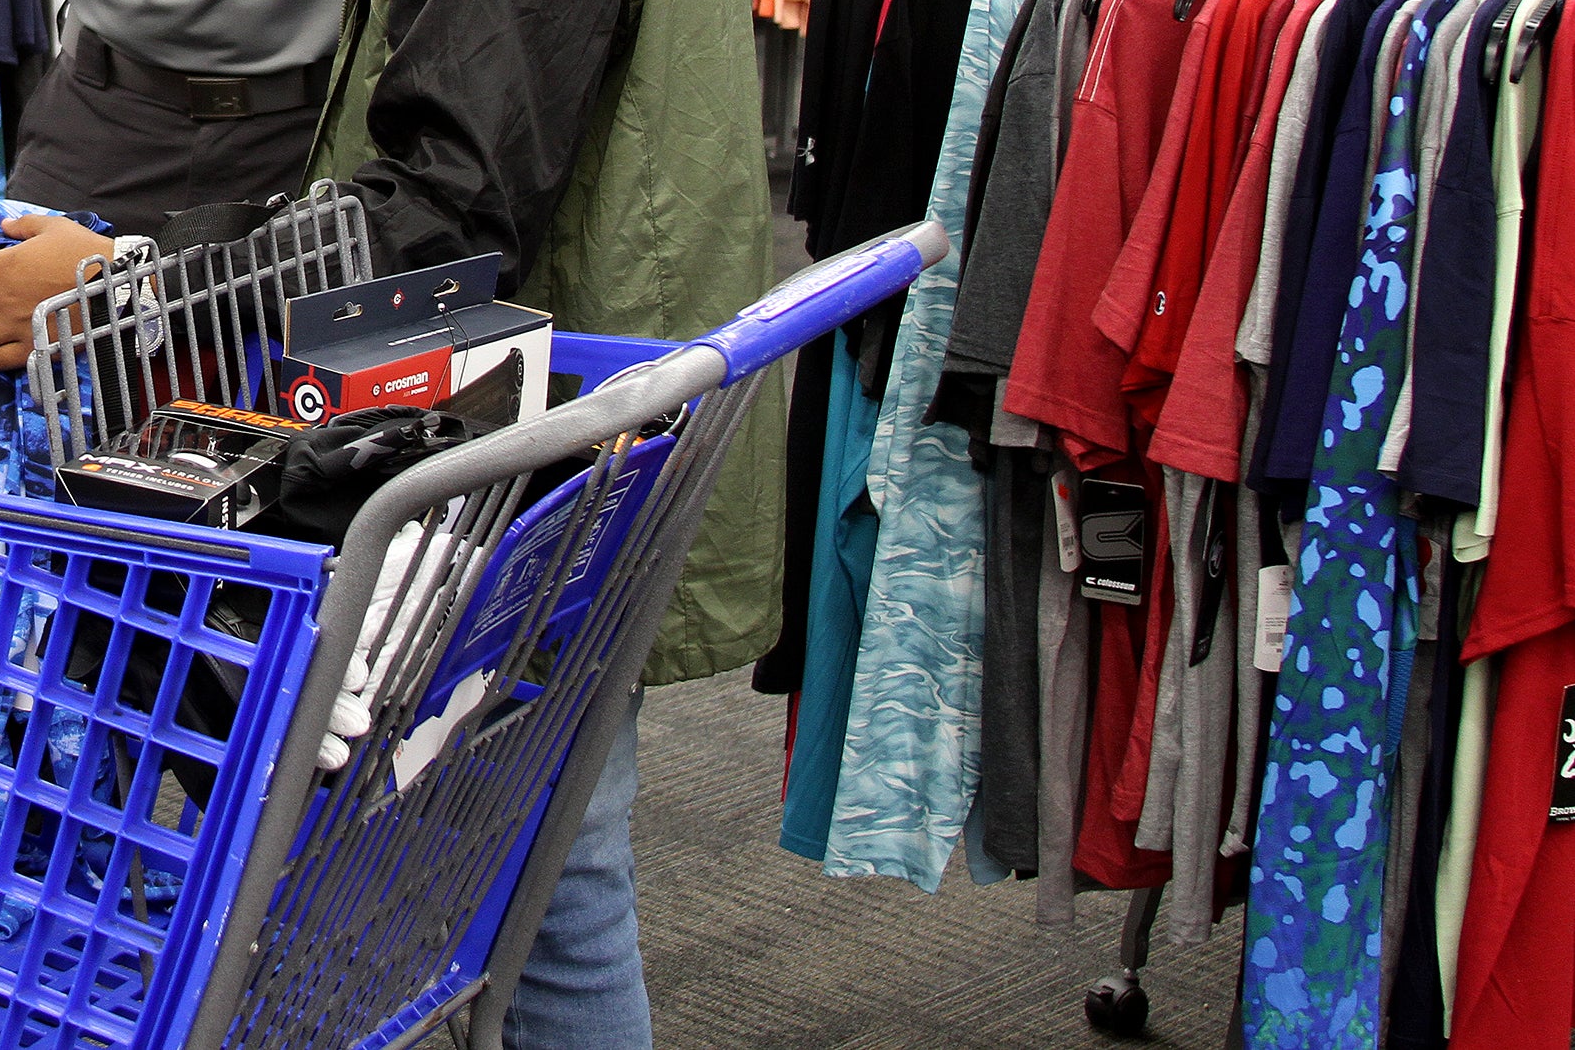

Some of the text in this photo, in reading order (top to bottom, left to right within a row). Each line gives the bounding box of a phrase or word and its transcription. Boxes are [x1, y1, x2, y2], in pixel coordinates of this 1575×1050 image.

[384, 371, 429, 394] crosman
[78, 453, 225, 488] MAX AIRFLOW
[106, 467, 195, 491] TETHER INCLUDED
[1096, 578, 1136, 591] colosseum
